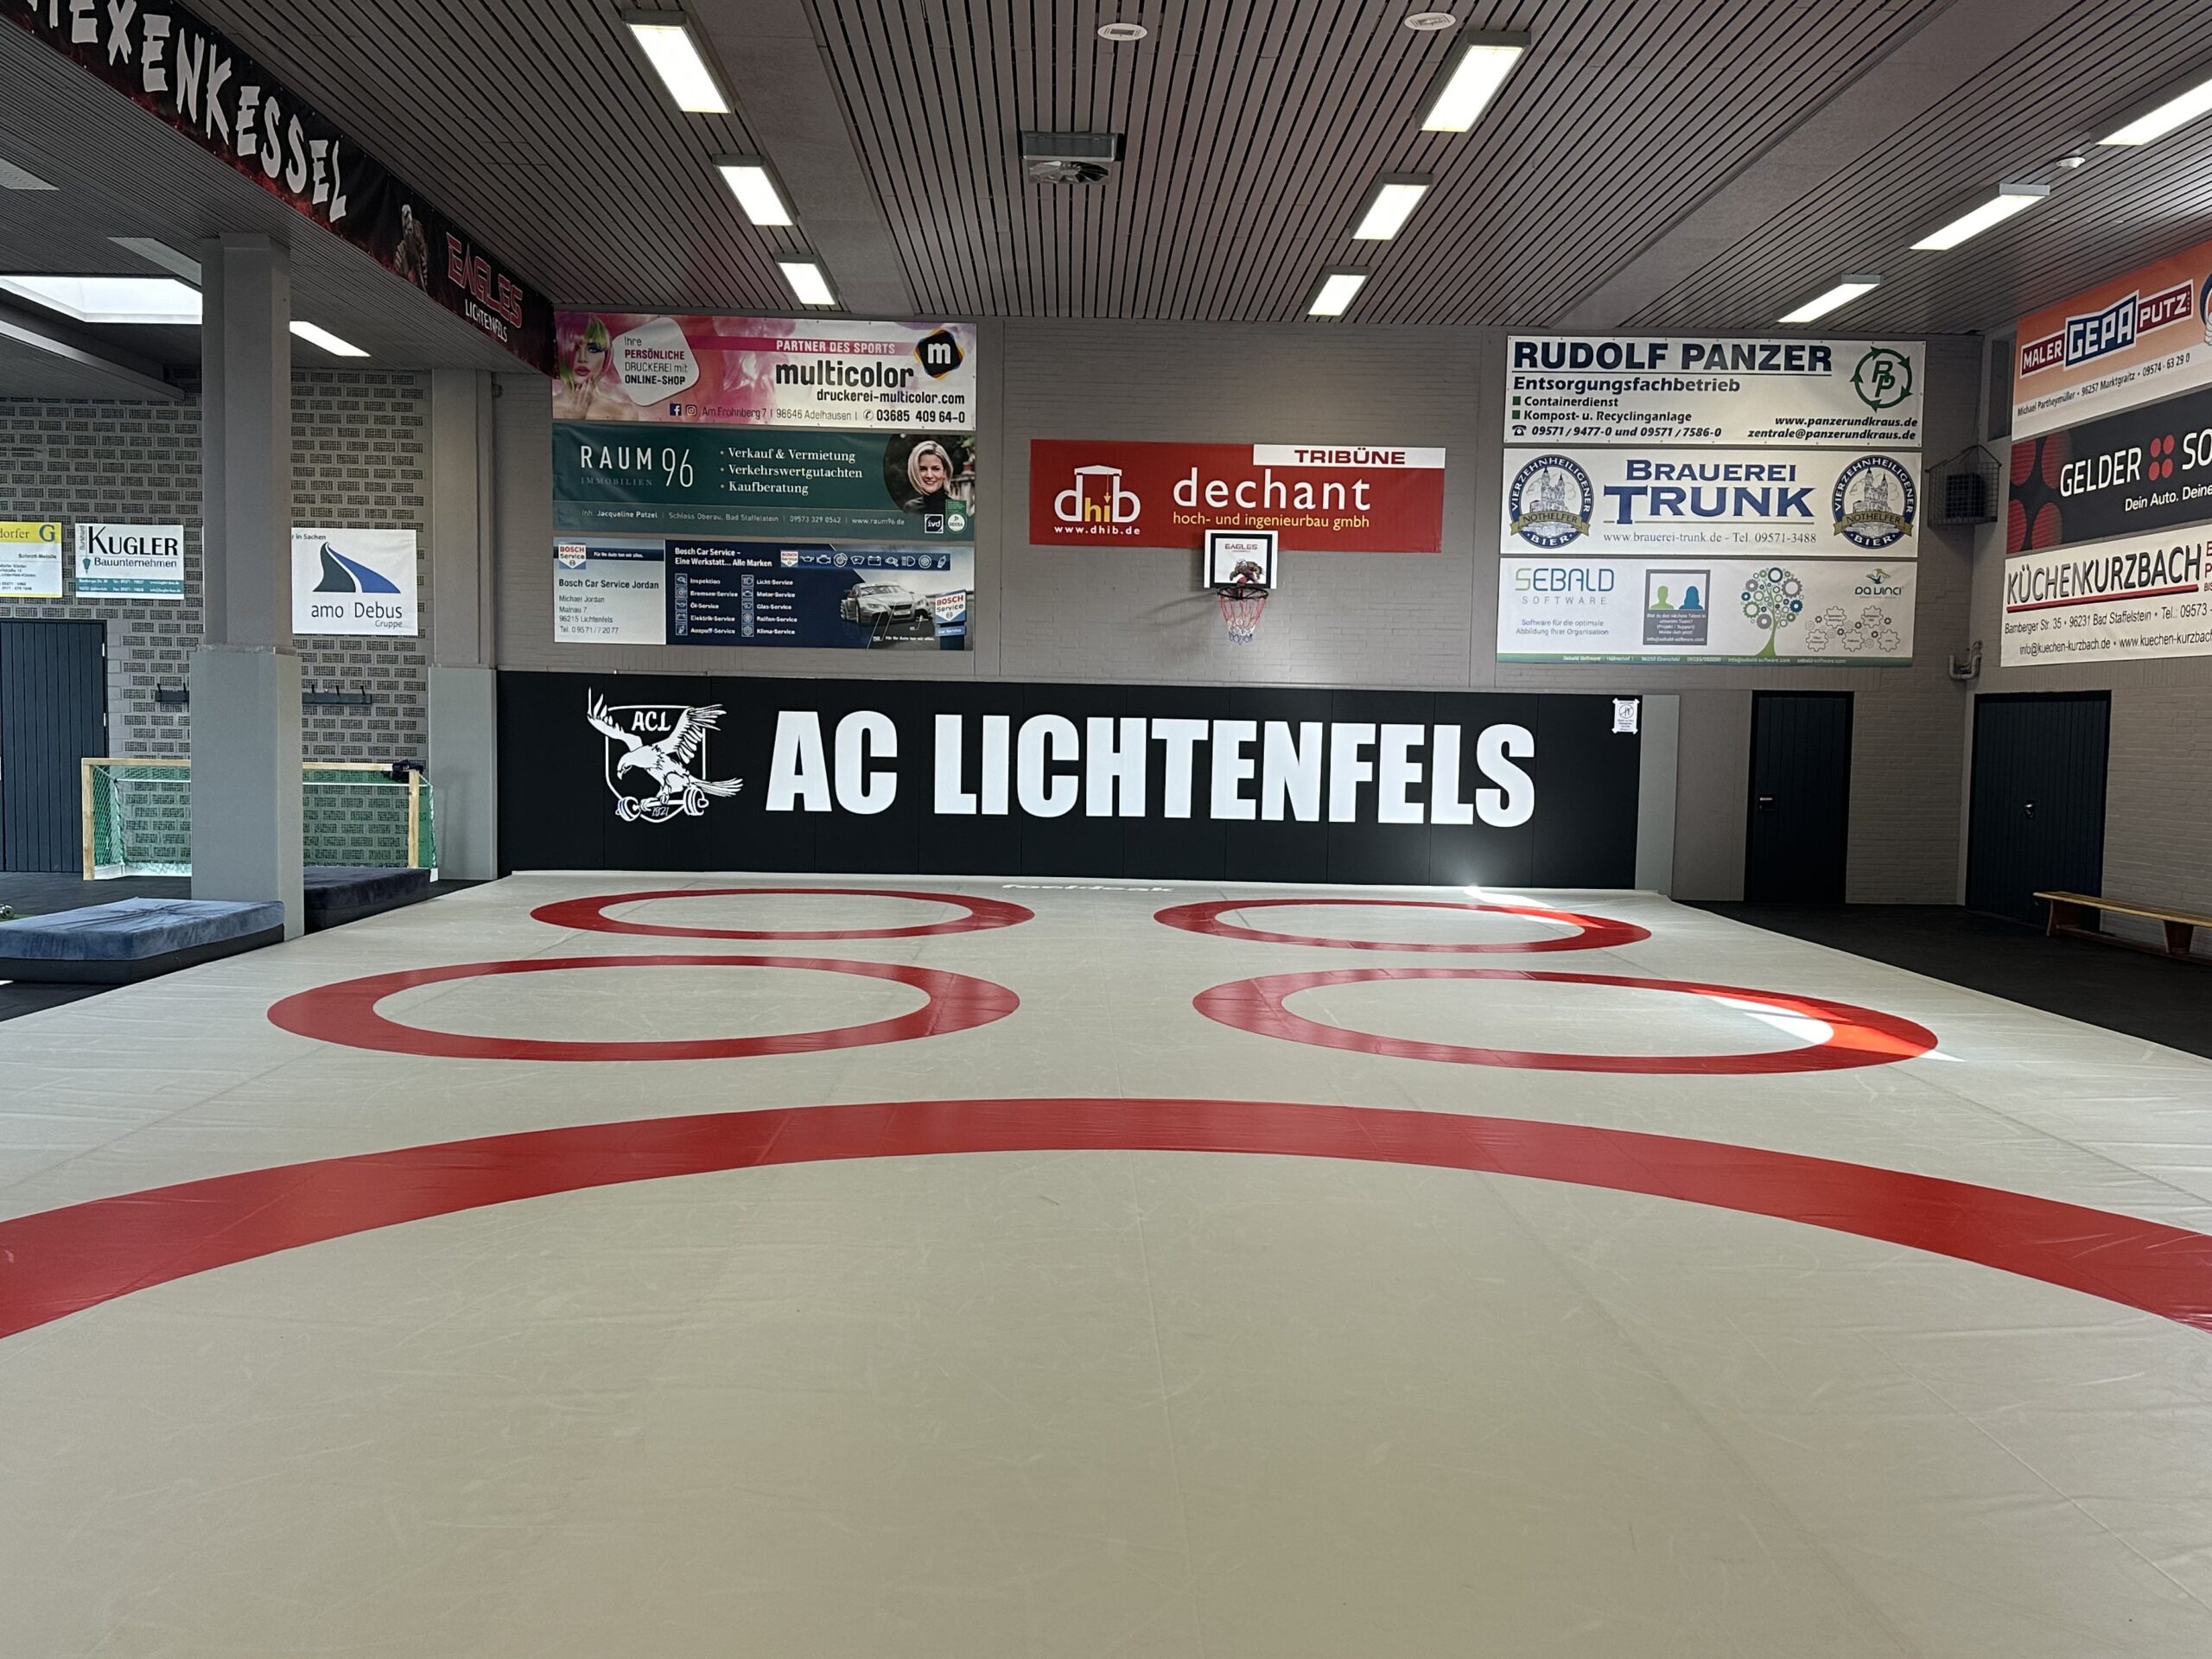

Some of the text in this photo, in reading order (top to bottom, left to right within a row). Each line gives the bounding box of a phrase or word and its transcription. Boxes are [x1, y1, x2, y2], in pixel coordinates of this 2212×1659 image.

[27, 0, 346, 223] EXENKESSEL
[446, 232, 523, 328] EAGLES
[2139, 291, 2188, 328] PUTZ
[465, 299, 507, 342] LICHTENFELS
[2068, 302, 2134, 361] GEPA
[624, 336, 642, 346] Ihre
[776, 340, 895, 354] PARTNER DES SPORTS
[624, 348, 685, 360] PERSÖNLICHE
[1514, 341, 1832, 372] RUDOLF PANZER
[2023, 339, 2063, 370] MALER
[624, 361, 688, 373] DRUCKEREI mit
[776, 360, 914, 388] multicolor
[624, 374, 686, 385] ONLINE-SHOP
[1514, 376, 1740, 395] Entsorgungsfachbetrieb
[817, 389, 965, 404] druckerei-multicolor.com
[2017, 402, 2037, 416] Michael
[2037, 391, 2075, 410] Partheymüller
[2100, 372, 2135, 391] Marktgraitz
[2142, 362, 2161, 377] 09574
[1524, 396, 1618, 407] Containerdienst
[702, 406, 965, 423] Am Frohnberg 7 98646 Adelhausen 03685 409 64-0
[1523, 410, 1580, 422] Kompost-
[1596, 410, 1692, 424] Recyclinganlage
[1775, 416, 1917, 428] www.panzerundkraus.de
[1532, 426, 1722, 437] 09571 9477-0 und 09571 7586-0
[1747, 428, 1916, 441] zentrale@panzerundkraus.de
[728, 448, 855, 464] Verkauf & Vermietung
[1294, 447, 1406, 465] TRIBÜNE
[580, 445, 694, 487] RAUM 96
[728, 464, 862, 479] Verkehrswertgutachten
[1625, 459, 1796, 481] BRAUEREI
[2060, 447, 2142, 498] GELDER
[581, 477, 652, 486] IMMOBILIEN
[728, 481, 809, 496] Kaufberatung
[1173, 467, 1370, 511] dechant
[1511, 457, 1592, 512] VIERZEHNHEILIGENER
[1834, 457, 1914, 513] VIERZEHNHEILIGENER
[1604, 485, 1817, 524] TRUNK
[2125, 497, 2147, 512] Dein
[2150, 493, 2179, 506] Auto.
[597, 510, 634, 518] Jacqueline
[741, 513, 779, 523] Staffelstein
[1173, 512, 1370, 531] hoch- und ingenieurbau gmbh
[1522, 512, 1578, 524] NOTHELFER
[1846, 512, 1901, 524] NOTHELFER
[39, 524, 56, 543] G
[1054, 524, 1141, 535] www.dhib.de
[1604, 531, 1816, 543] www.brauerei-trunk.de Tel. 09571-3488
[88, 525, 179, 556] KUGLER
[1530, 535, 1569, 546] BIER
[1854, 535, 1892, 546] BIER
[94, 557, 177, 568] Bauunternehmen
[1515, 568, 1614, 592] SEBALD
[2007, 543, 2202, 605] KÜCHENKURZBACH
[559, 578, 659, 589] Bosch Car Service Jordan
[937, 594, 963, 606] BOSCH
[937, 603, 963, 612] Service
[1522, 595, 1607, 605] SOFTWARE
[311, 601, 403, 619] amo Debus
[375, 620, 403, 629] Gruppe
[1574, 619, 1605, 628] optimale
[2005, 602, 2208, 635] Bamberger 35 96231 Bad Staffelstein 09573
[1516, 627, 1548, 636] Abbildung
[2019, 637, 2110, 657] info@kuechen-kurzbach.de
[631, 710, 671, 732] ACL
[766, 709, 1535, 828] AC LICHTENFELS
